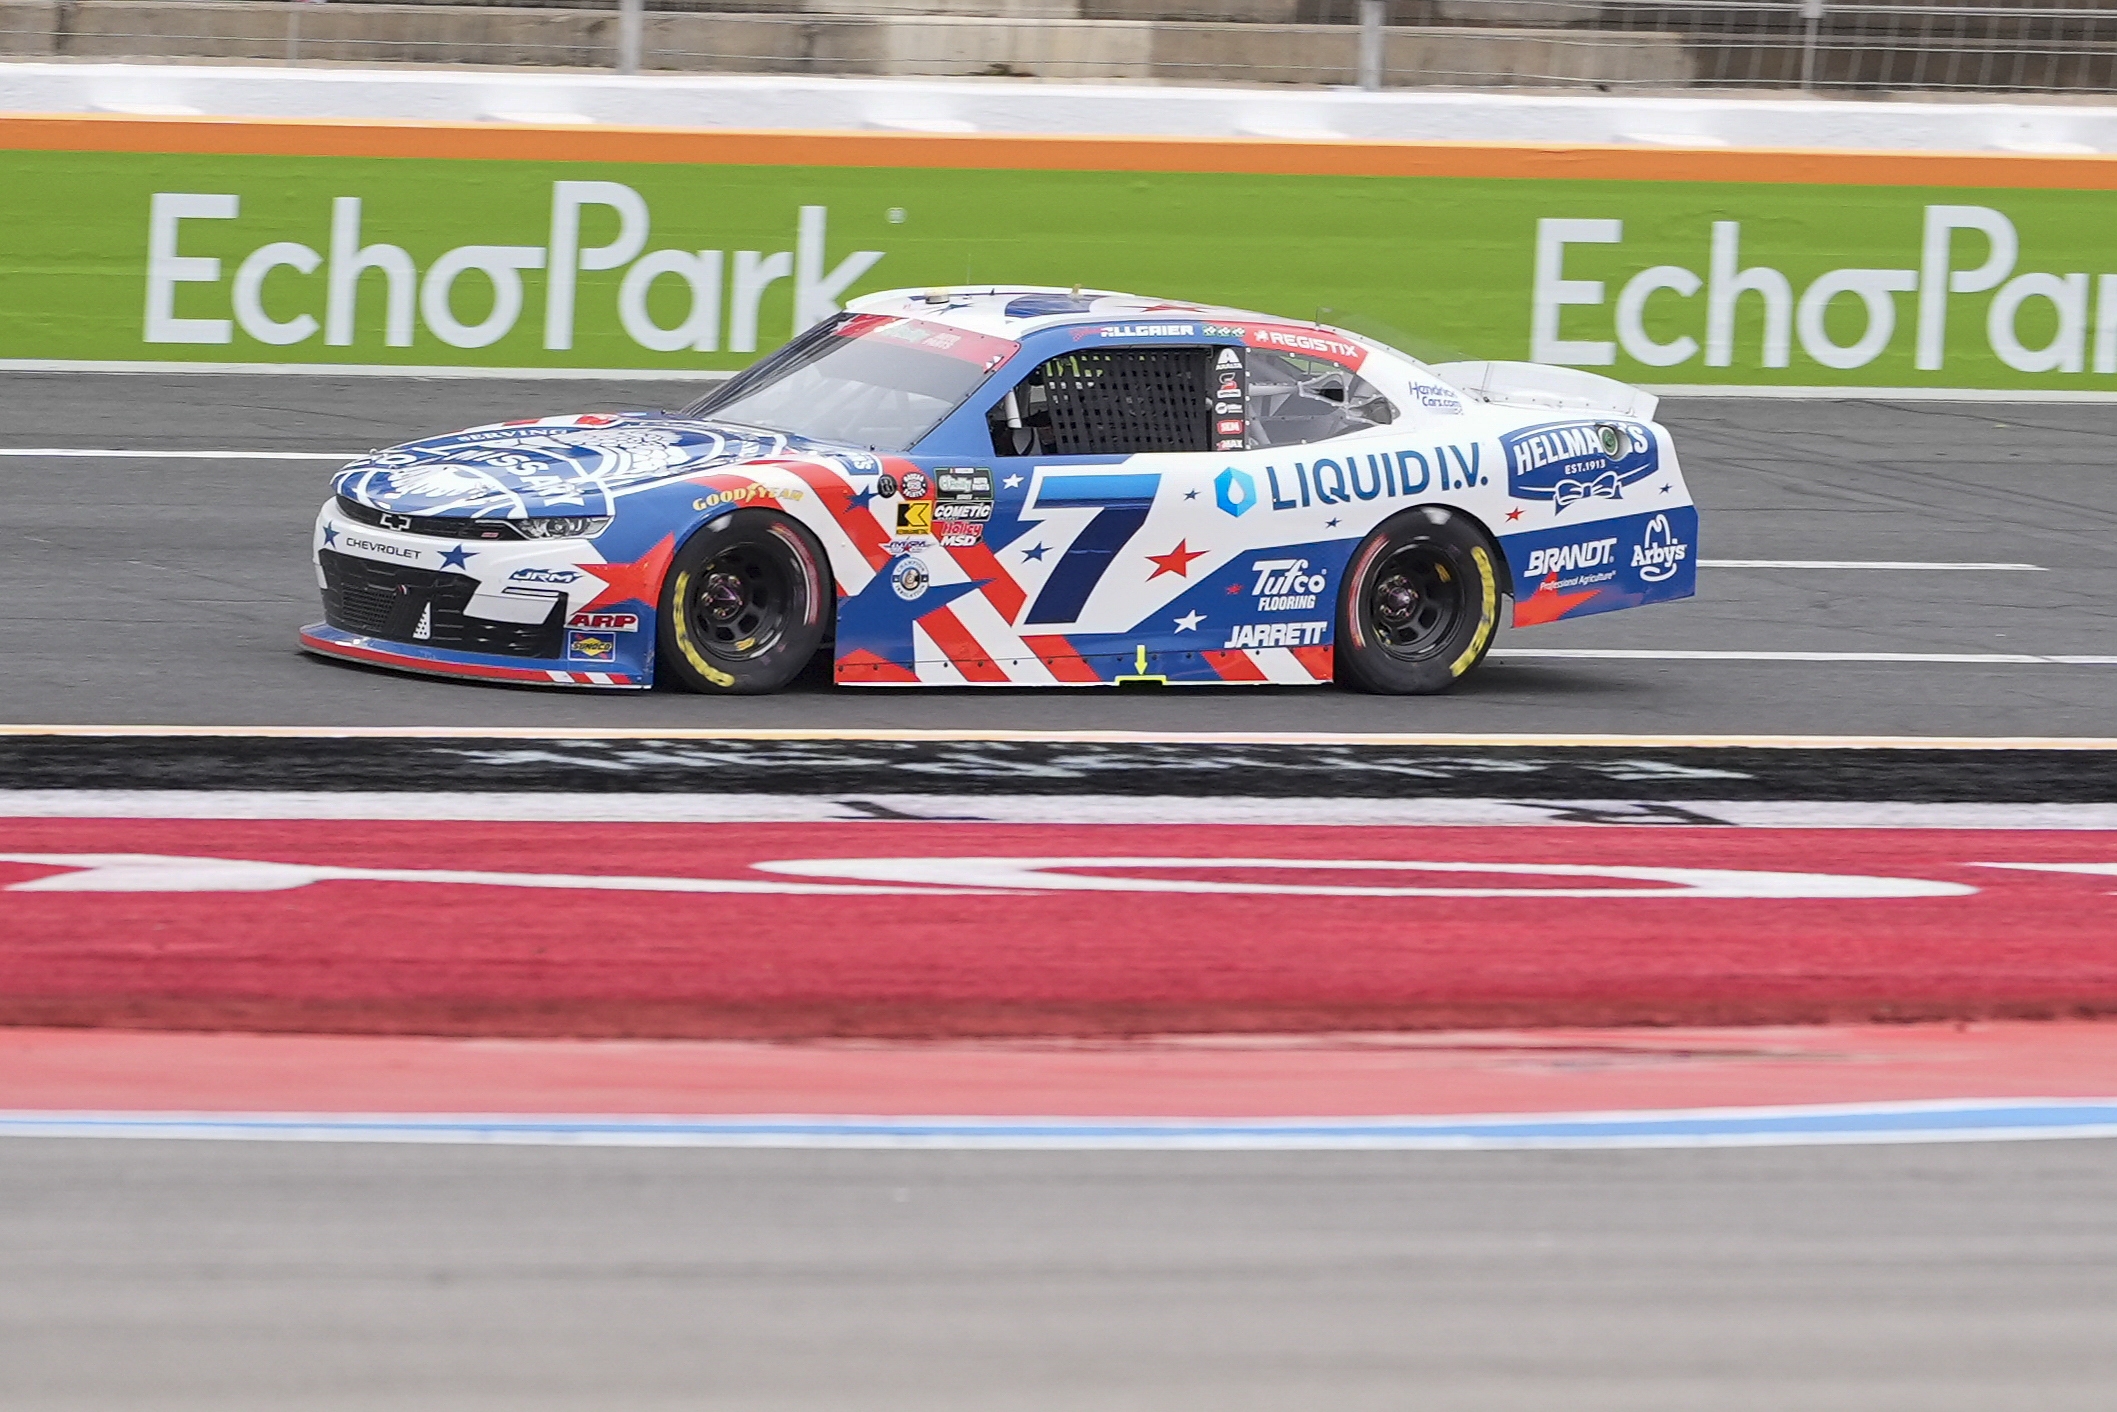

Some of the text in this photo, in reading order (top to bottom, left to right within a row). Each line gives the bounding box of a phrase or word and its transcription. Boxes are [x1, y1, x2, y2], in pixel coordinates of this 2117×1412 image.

[143, 181, 885, 352] EchoPark
[1269, 331, 1359, 358] REGISTIX
[1512, 420, 1649, 476] HELLMA'S
[1265, 442, 1489, 511] LIQUID I.V.
[692, 484, 804, 511] GOODYEAR
[934, 502, 990, 518] COMETIC
[346, 538, 422, 559] CHEVROLET
[940, 536, 977, 547] MSD
[1024, 473, 1162, 625] 7
[1630, 538, 1688, 567] Arby's
[1524, 537, 1618, 578] BRANDT
[512, 571, 575, 583] JRM
[1251, 559, 1326, 596] Tufco
[1257, 594, 1317, 612] FLOORING
[567, 614, 637, 628] ARP
[571, 642, 613, 652] SUNOCO
[1223, 621, 1329, 649] JARRETT
